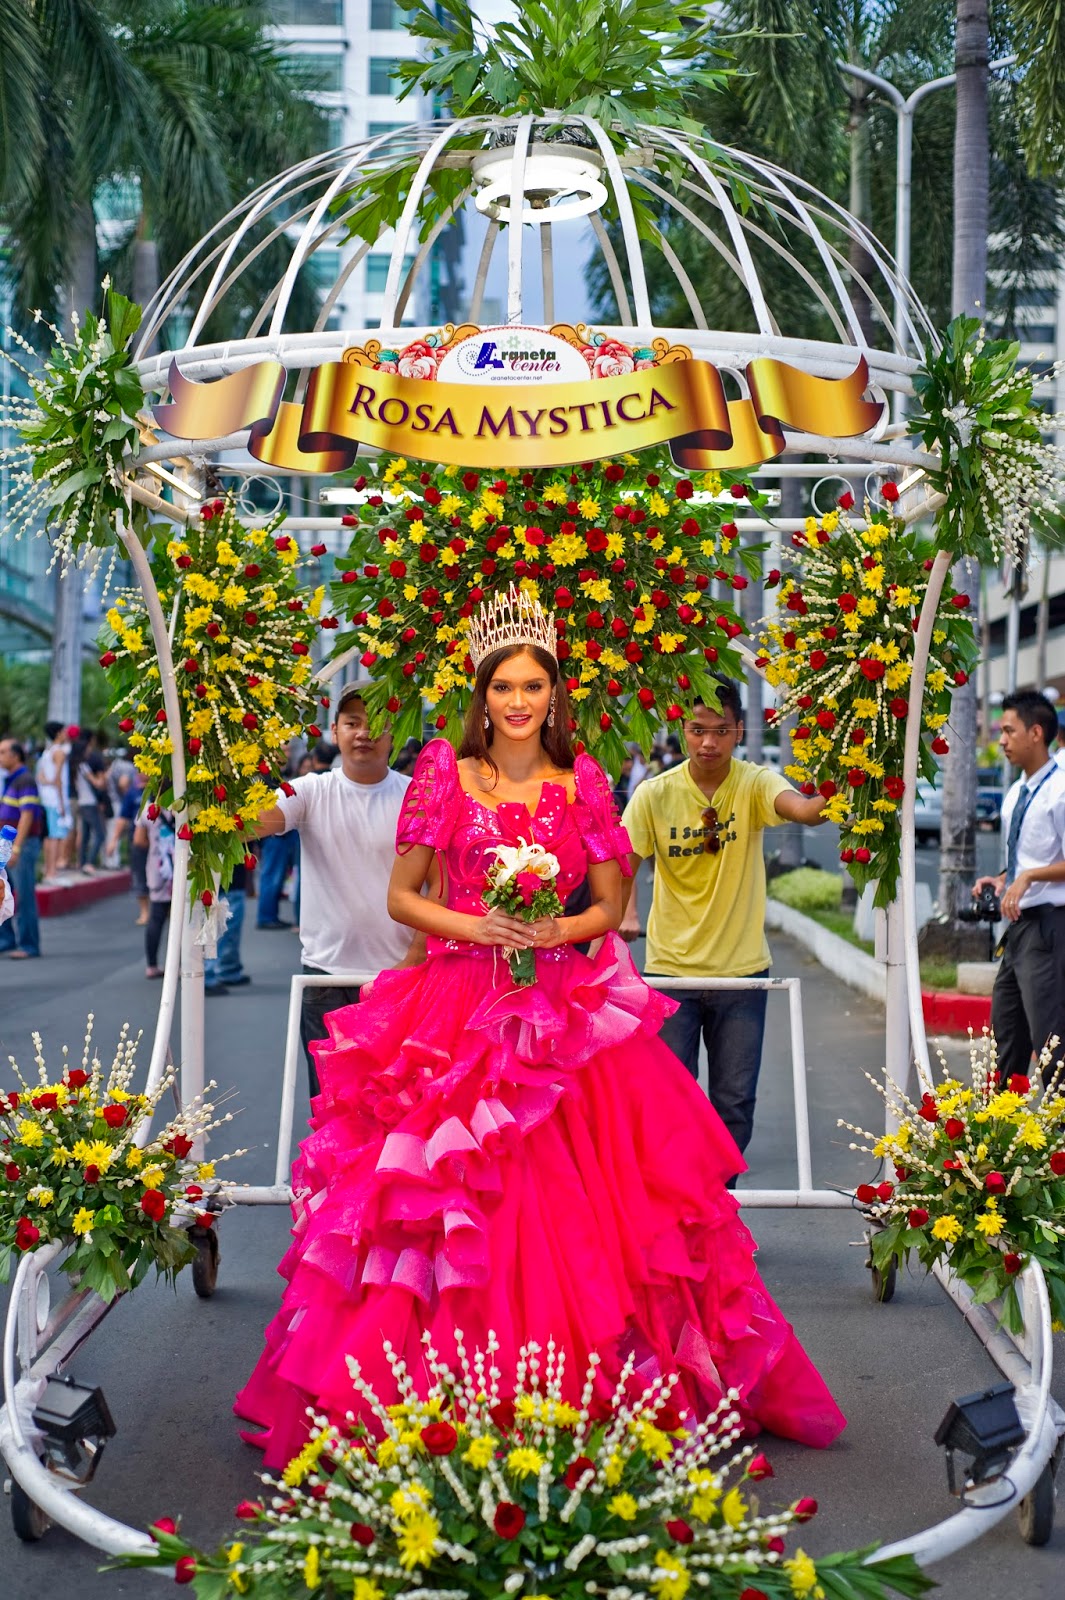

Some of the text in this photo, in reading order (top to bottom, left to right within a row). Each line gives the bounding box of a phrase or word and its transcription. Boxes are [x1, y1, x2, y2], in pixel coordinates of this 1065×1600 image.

[474, 342, 556, 369] Araneta
[508, 355, 562, 372] Center
[346, 383, 677, 437] ROSA MYSTICA
[670, 827, 677, 839] I
